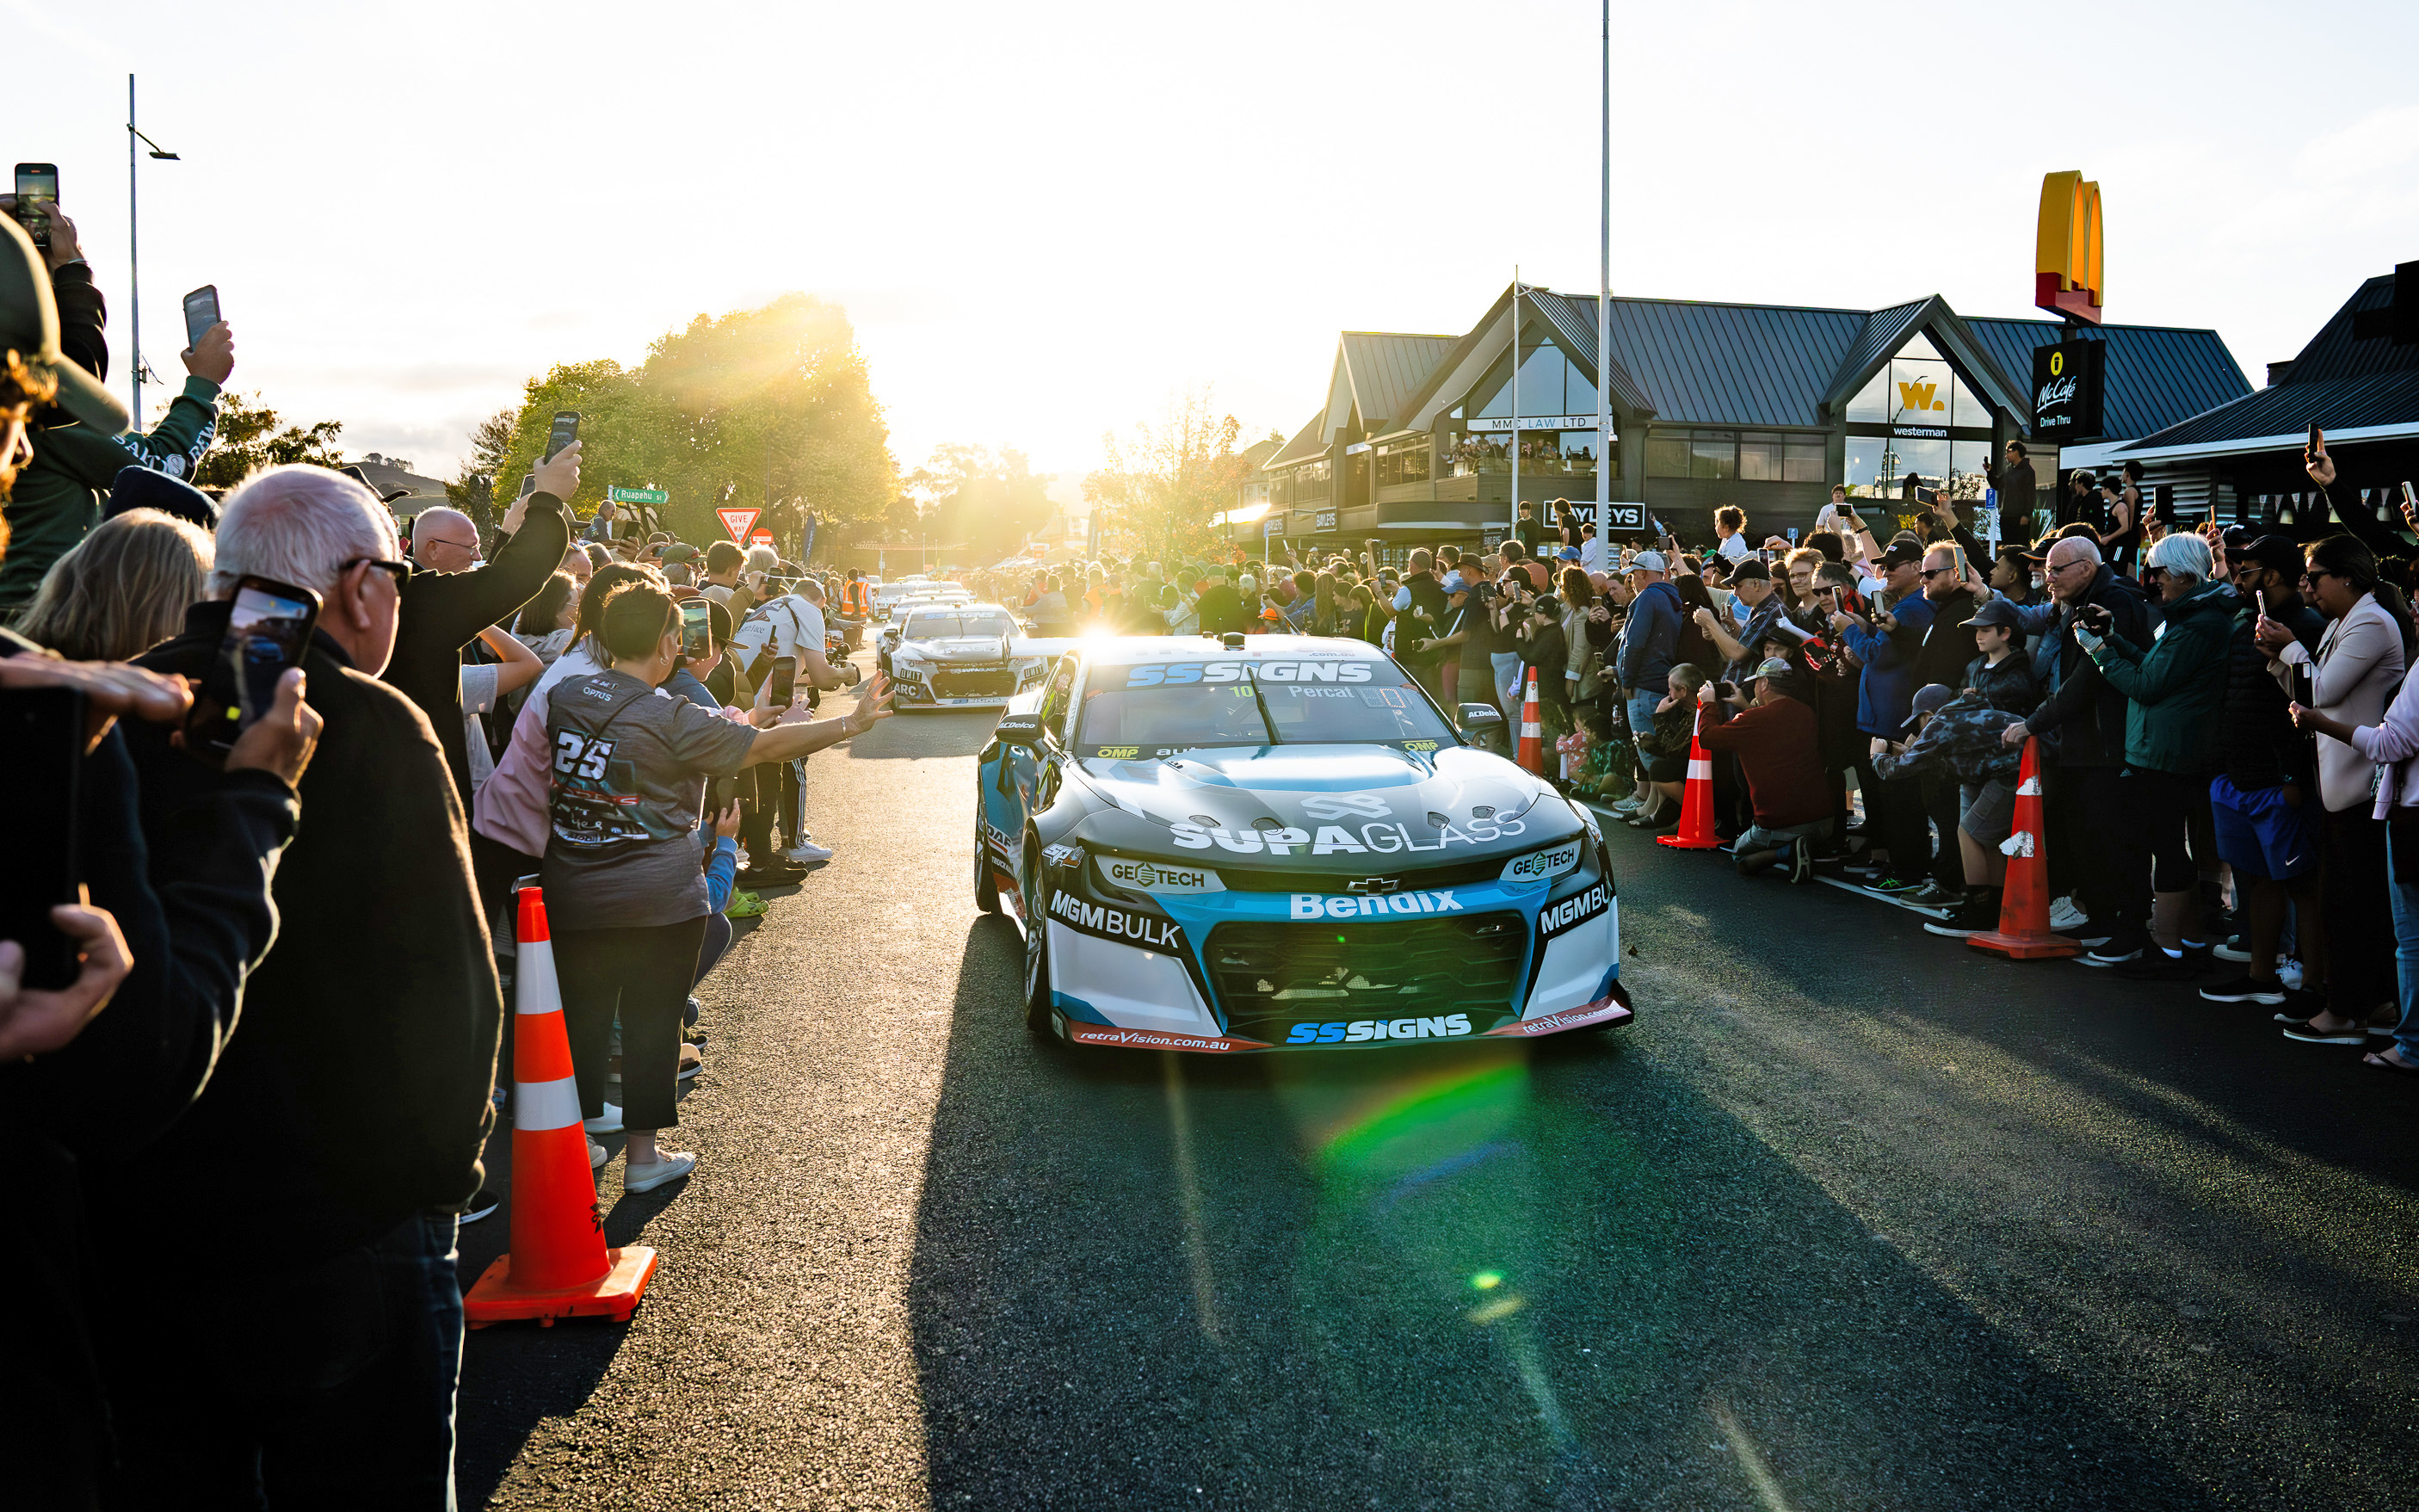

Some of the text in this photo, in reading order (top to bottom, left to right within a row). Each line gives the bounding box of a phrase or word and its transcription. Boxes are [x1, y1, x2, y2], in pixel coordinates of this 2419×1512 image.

[2037, 376, 2077, 411] McCafé
[1528, 418, 1556, 429] LAW
[1563, 417, 1586, 428] LTD
[2039, 415, 2071, 428] Drive Thru
[1893, 427, 1947, 437] westerman
[621, 490, 652, 500] Ruapehu
[730, 515, 748, 523] GIVE
[1317, 513, 1336, 528] BAYLEYS
[583, 687, 613, 702] OPTUS
[1229, 685, 1355, 699] 10 Percat
[1468, 710, 1500, 719] ACDelco
[1097, 748, 1139, 758] OMP
[1404, 741, 1439, 751] OMP
[554, 731, 613, 781] 25
[986, 824, 1012, 848] DAF
[1169, 810, 1527, 855] SUPAGLASS
[1290, 889, 1464, 920] Bendix
[1080, 1031, 1231, 1051] retraVision.com.au
